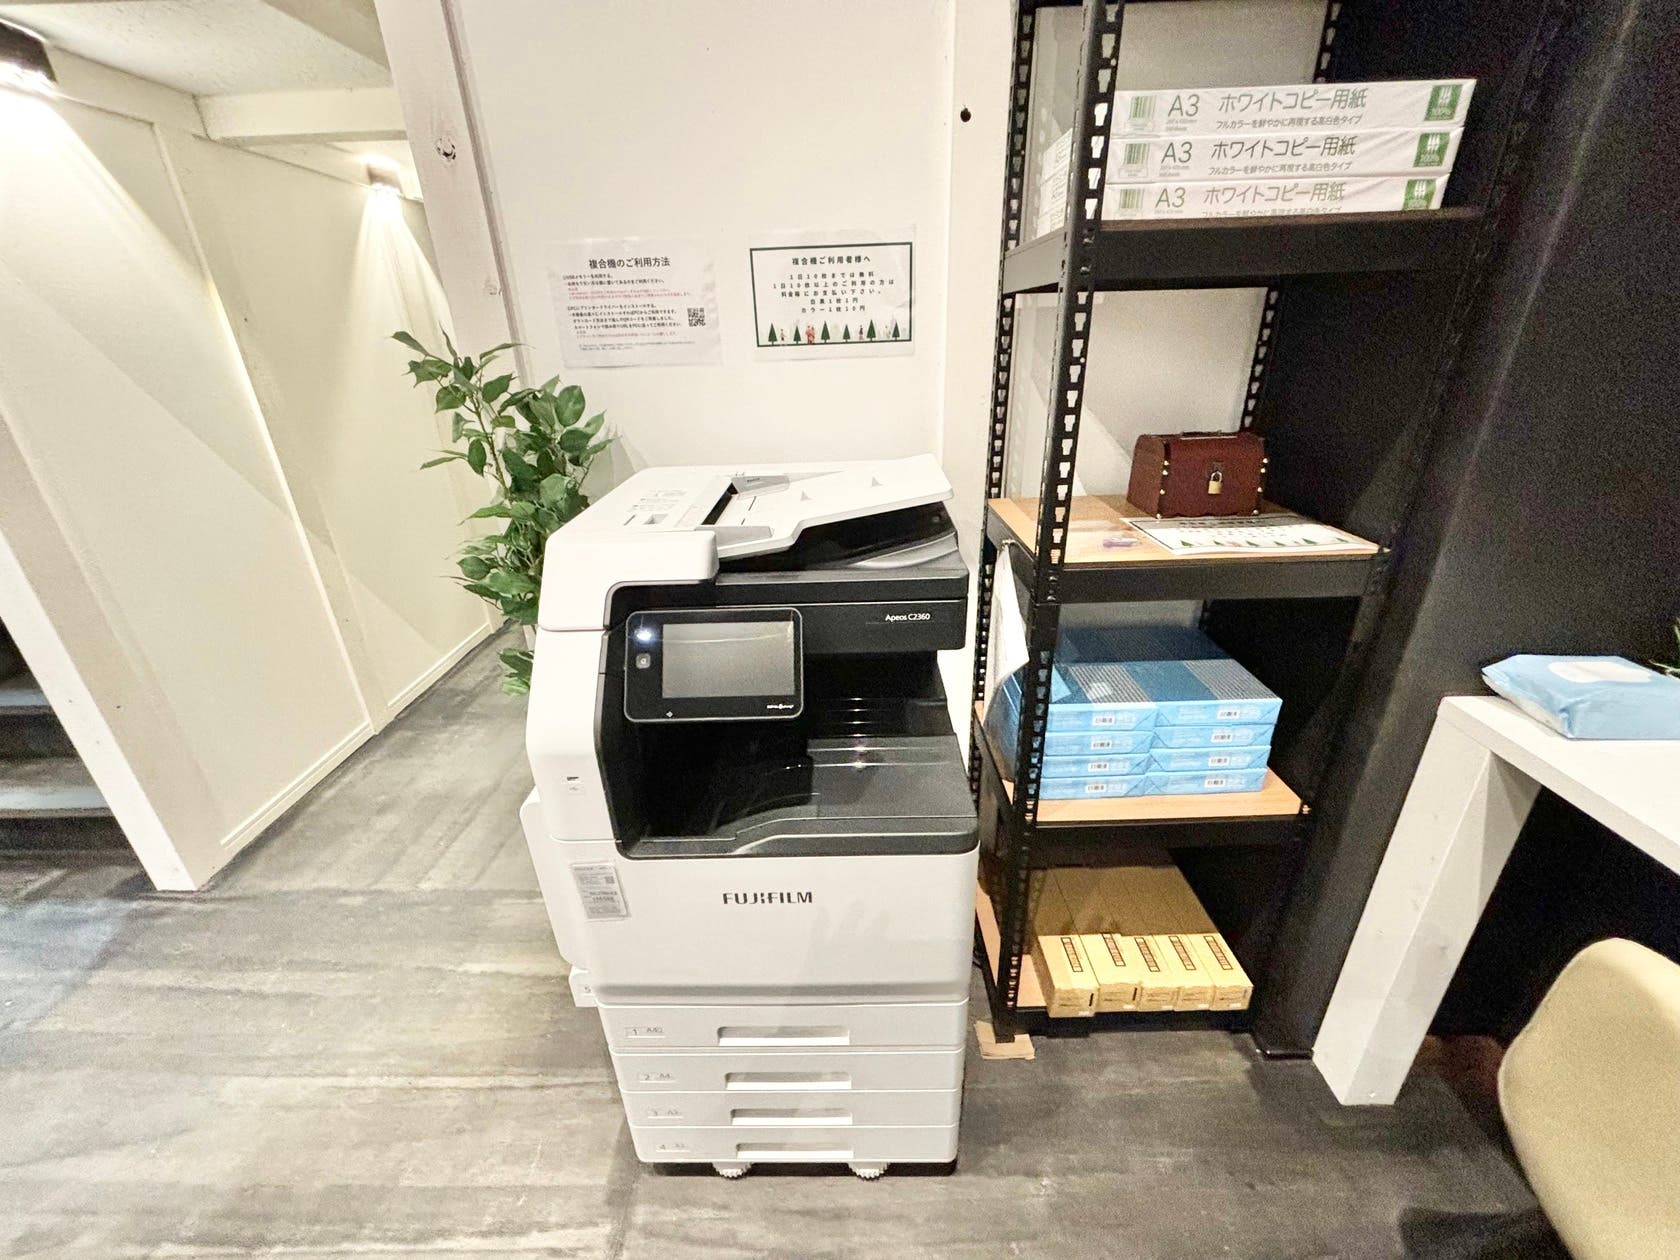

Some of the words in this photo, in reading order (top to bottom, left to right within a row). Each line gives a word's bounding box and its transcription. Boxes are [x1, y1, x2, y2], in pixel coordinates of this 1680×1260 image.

[1167, 94, 1200, 117] A3
[1218, 88, 1368, 112] ホワイトコピー用紙
[1161, 141, 1193, 164] A3
[1211, 135, 1358, 160] ホワイトコピー用紙
[1155, 187, 1186, 208] A3
[1203, 181, 1347, 205] ホワイトコピー用紙
[589, 256, 671, 270] 複合機のご利用方法
[885, 614, 907, 623] Apeos
[908, 612, 931, 621] C2360
[723, 891, 813, 905] FUJIFILM
